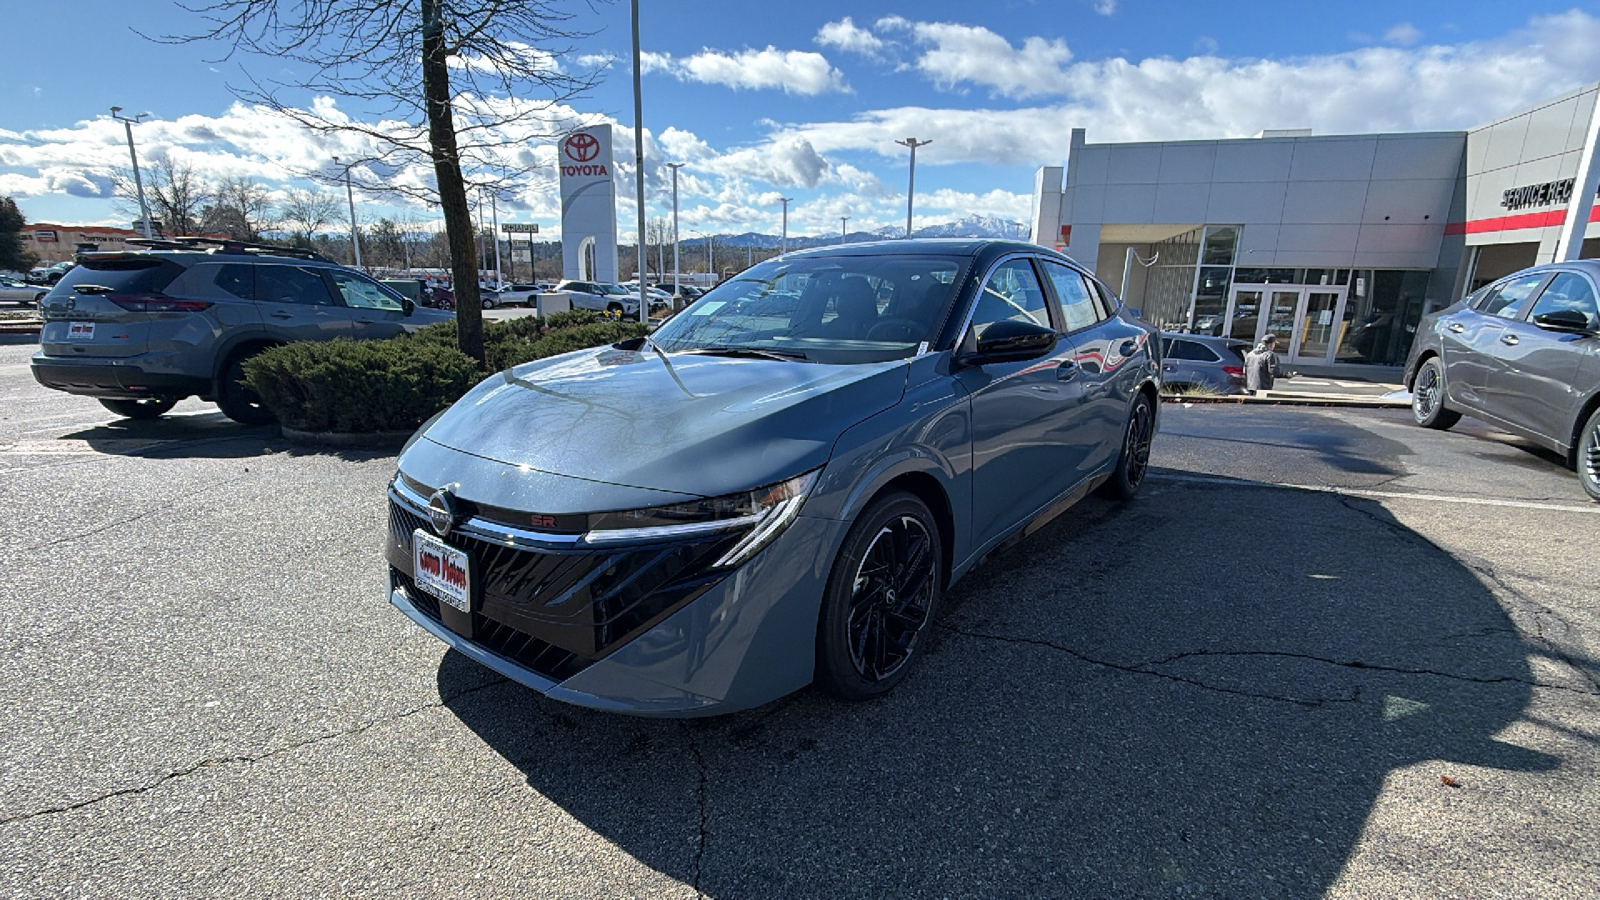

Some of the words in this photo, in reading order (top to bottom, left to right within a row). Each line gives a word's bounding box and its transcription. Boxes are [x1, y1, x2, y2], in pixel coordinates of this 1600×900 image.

[560, 165, 608, 177] TOYOTA
[1502, 183, 1547, 206] SERVICE
[1547, 177, 1576, 201] REC
[531, 514, 556, 527] SR
